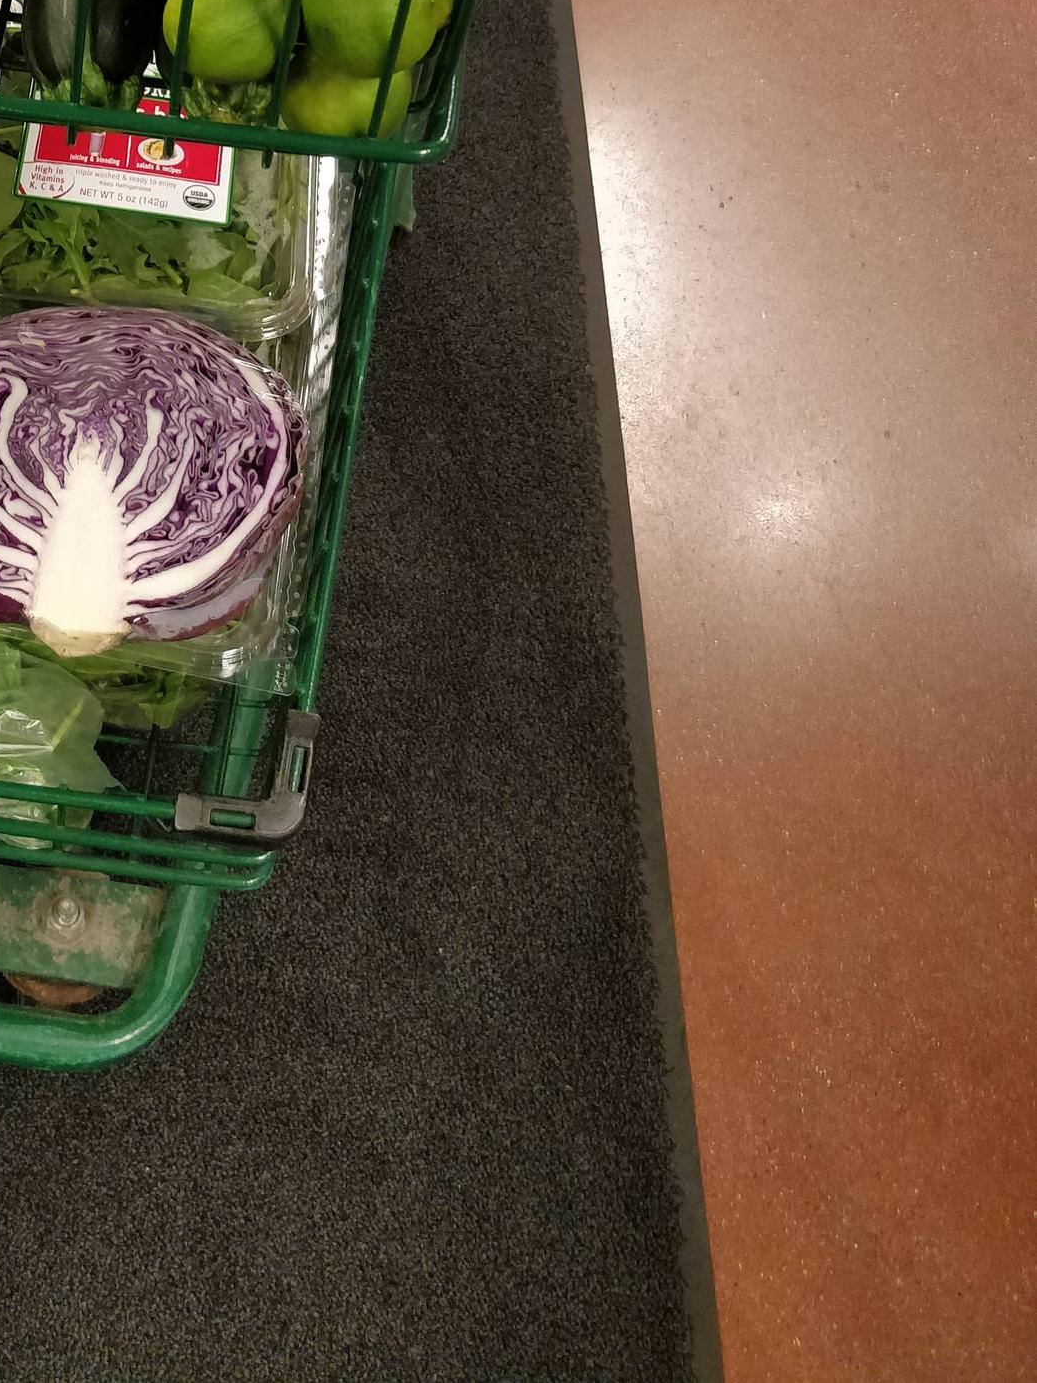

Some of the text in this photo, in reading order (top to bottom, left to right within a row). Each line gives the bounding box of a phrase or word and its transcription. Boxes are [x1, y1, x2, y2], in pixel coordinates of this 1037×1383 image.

[35, 164, 64, 174] High in
[136, 162, 155, 171] salads
[30, 172, 65, 184] Vitamins
[94, 171, 120, 181] washed
[129, 174, 148, 185] ready
[158, 178, 177, 189] enjoy
[40, 182, 47, 191] C
[49, 183, 55, 191] &
[57, 184, 64, 192] A
[79, 187, 98, 198] NET
[99, 189, 115, 200] WT
[125, 194, 136, 203] oz
[138, 194, 169, 209] (142g)
[190, 190, 209, 198] USDA
